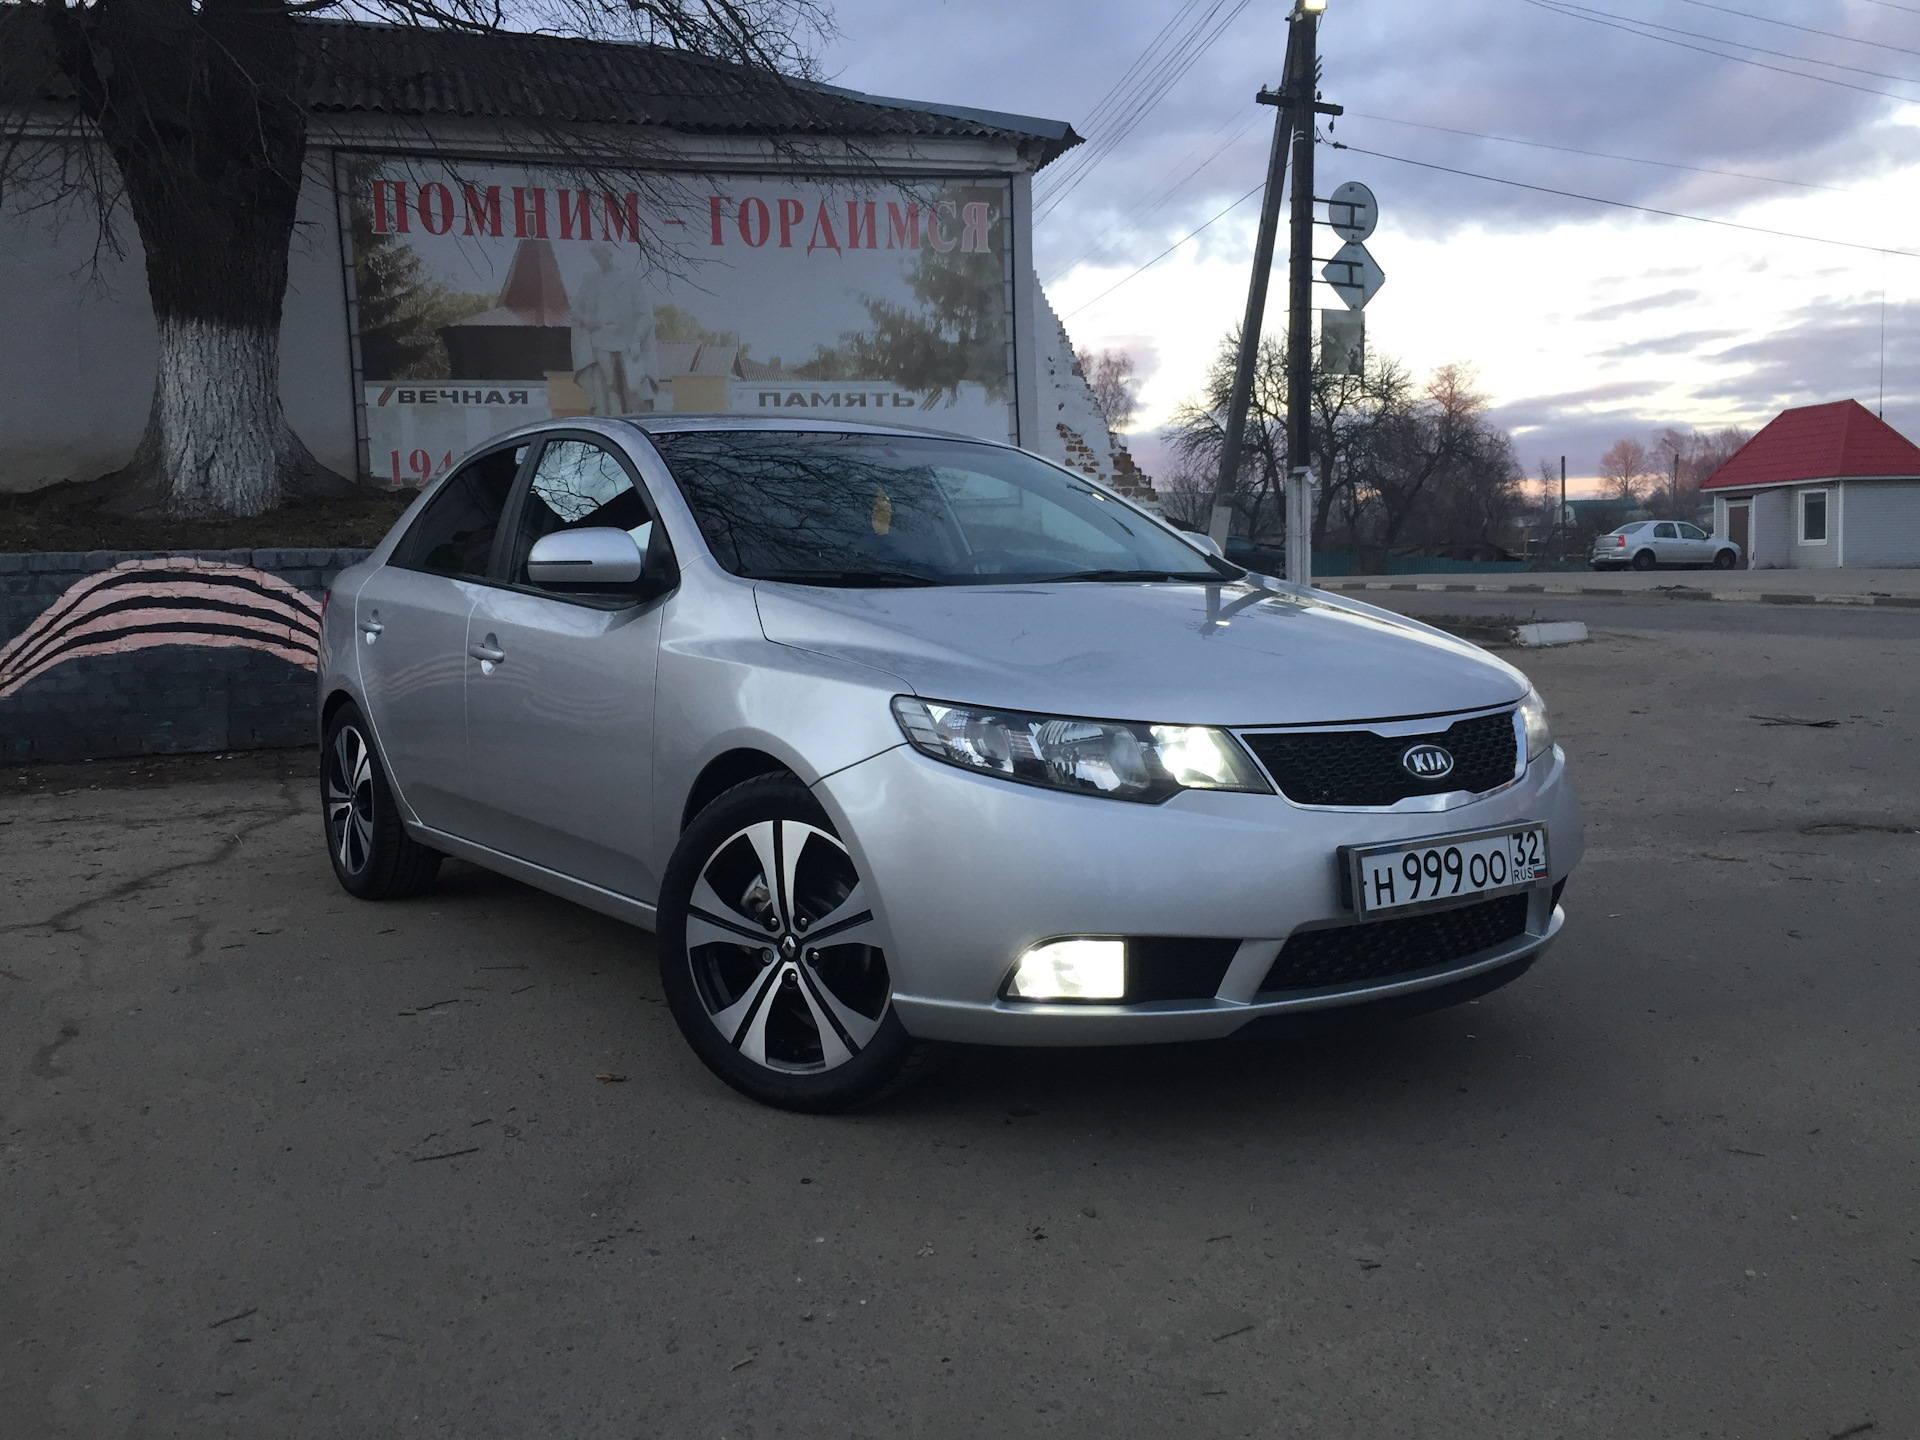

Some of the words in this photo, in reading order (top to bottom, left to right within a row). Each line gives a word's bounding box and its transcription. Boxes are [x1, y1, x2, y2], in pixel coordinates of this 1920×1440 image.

[371, 180, 640, 243] ПОМНИМ
[708, 195, 992, 259] ГОРДИМСЯ
[397, 390, 529, 405] ВЕЧНАЯ
[758, 391, 916, 408] ПАМЯТЬ
[1411, 751, 1449, 773] KIA
[1513, 867, 1534, 883] RUS
